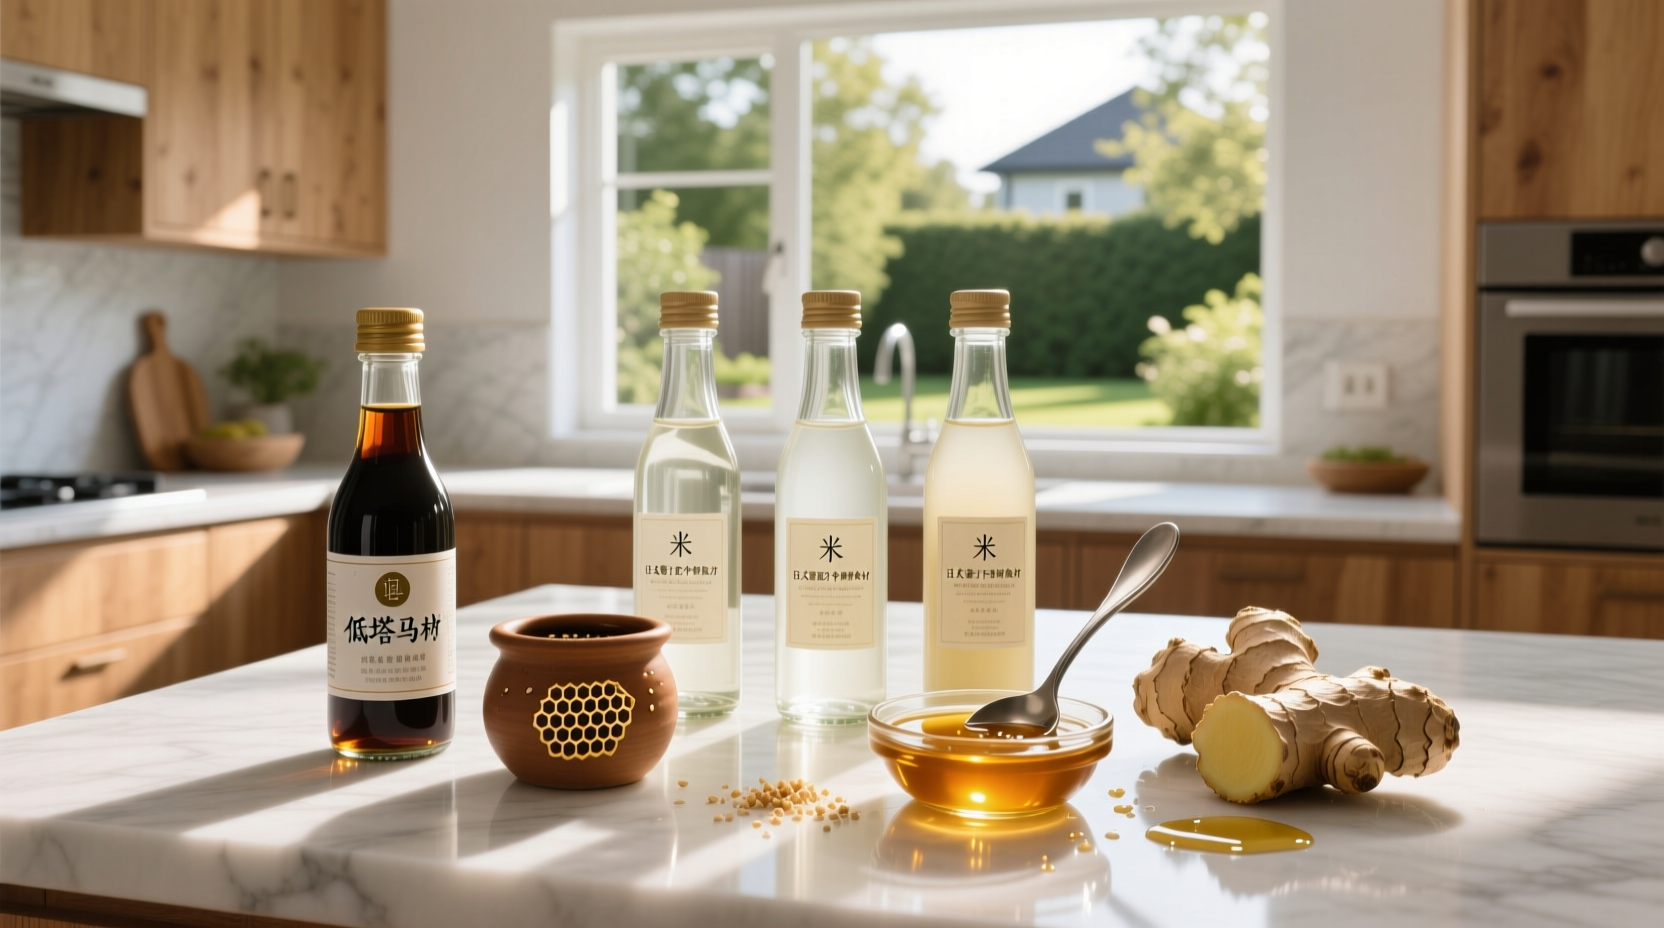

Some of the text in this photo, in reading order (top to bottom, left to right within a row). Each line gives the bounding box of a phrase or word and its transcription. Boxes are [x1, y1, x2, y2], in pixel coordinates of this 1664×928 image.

[670, 531, 692, 558] 米
[819, 535, 843, 563] 米
[973, 534, 996, 561] 米
